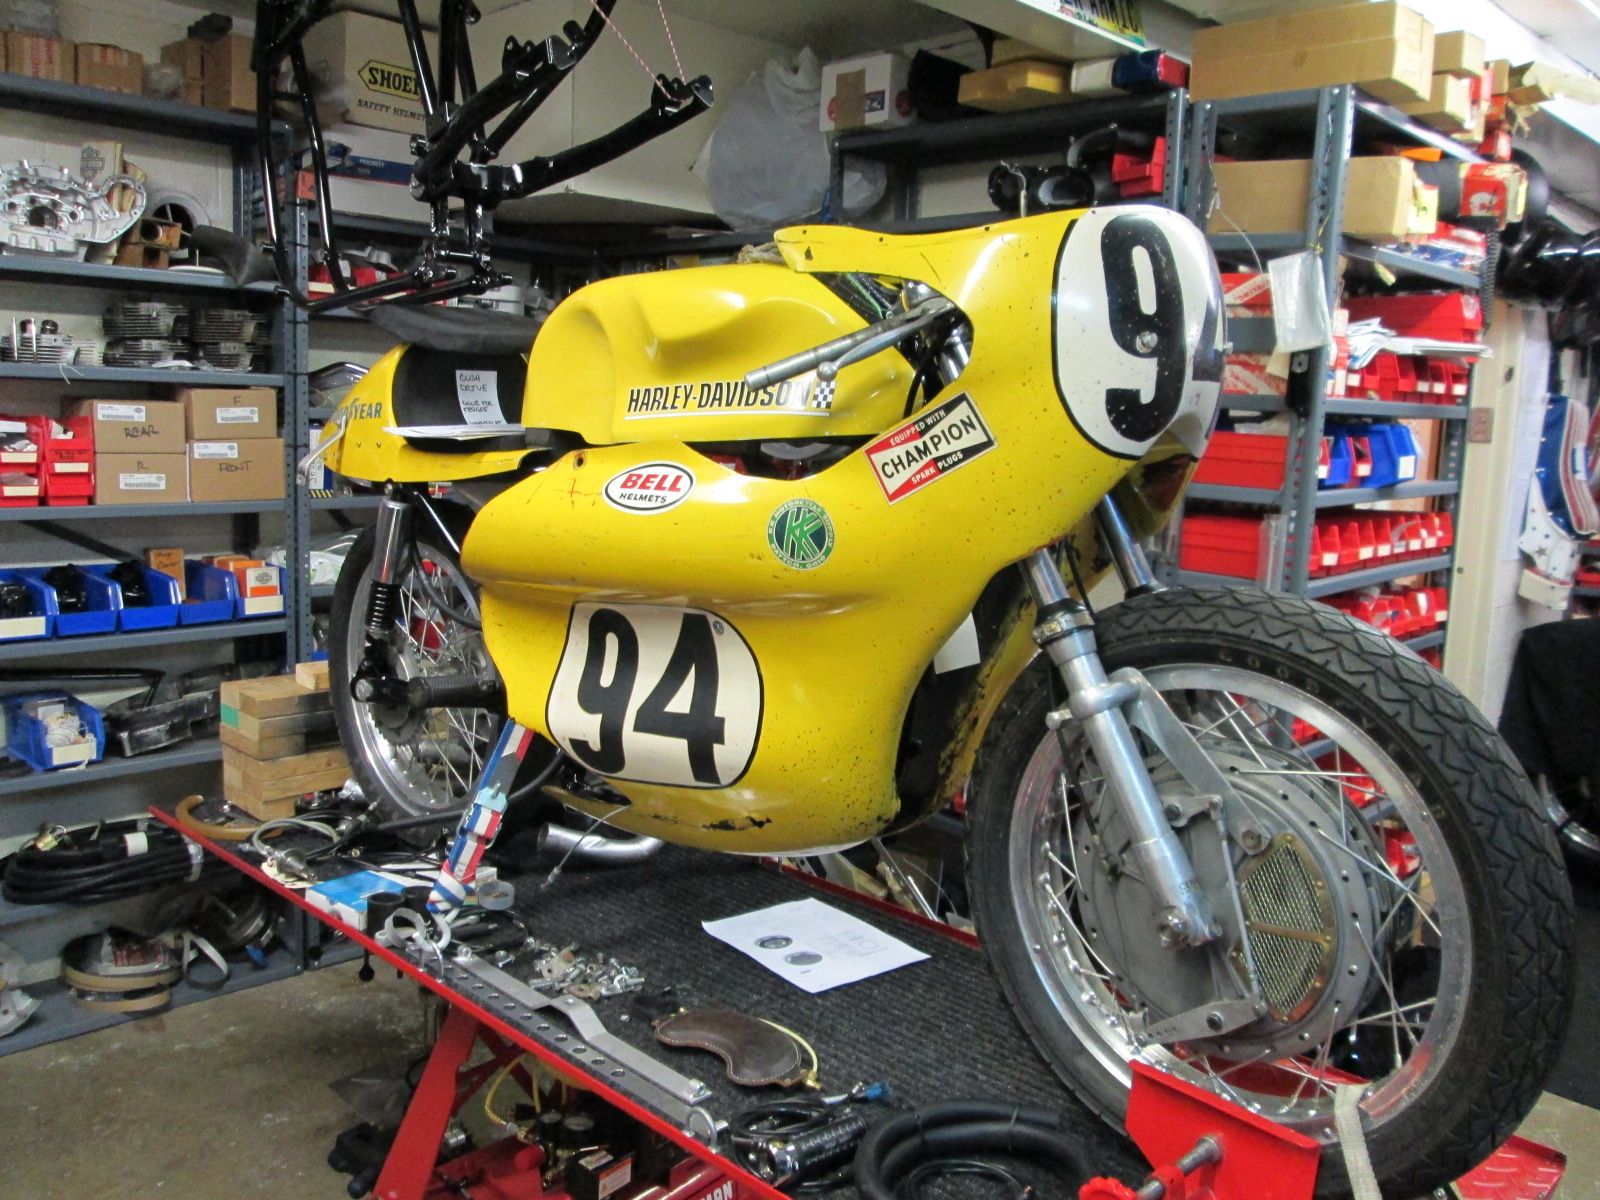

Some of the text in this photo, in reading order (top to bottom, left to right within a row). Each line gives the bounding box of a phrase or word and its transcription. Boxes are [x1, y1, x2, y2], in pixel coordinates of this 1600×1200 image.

[357, 99, 391, 113] SAFETY
[459, 373, 480, 382] CUSH
[627, 380, 811, 413] HARLEY-DAVIDSON
[124, 424, 160, 438] REAR
[890, 409, 946, 446] EQUIPPED WITH
[881, 415, 978, 480] CHAMPION
[217, 460, 254, 473] FRONT
[911, 451, 964, 485] SPARK PLUGS
[620, 473, 684, 493] BELL
[619, 493, 667, 504] HELMETS
[568, 608, 726, 785] 94
